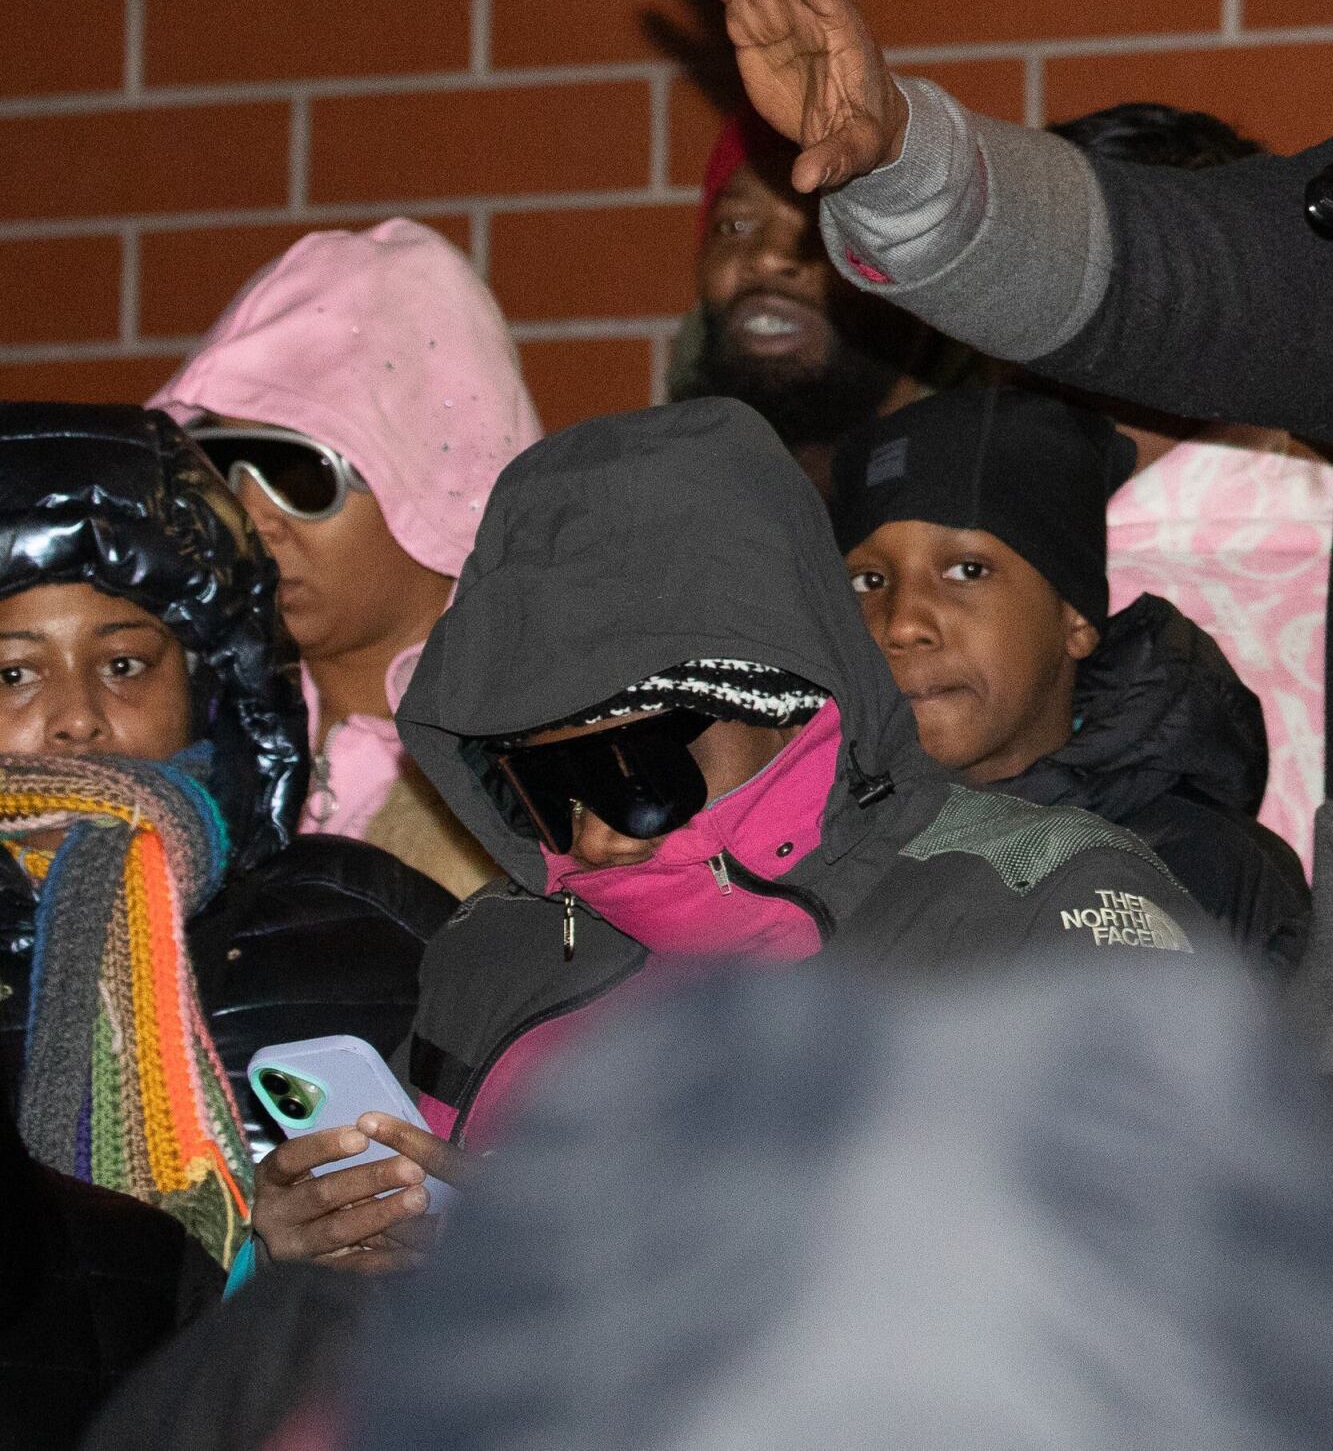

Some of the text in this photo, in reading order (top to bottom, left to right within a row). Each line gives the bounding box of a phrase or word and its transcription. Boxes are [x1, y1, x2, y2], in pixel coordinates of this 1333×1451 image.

[1095, 889, 1143, 913] THE
[1060, 907, 1149, 930] NORTH
[1092, 926, 1153, 948] FACE
